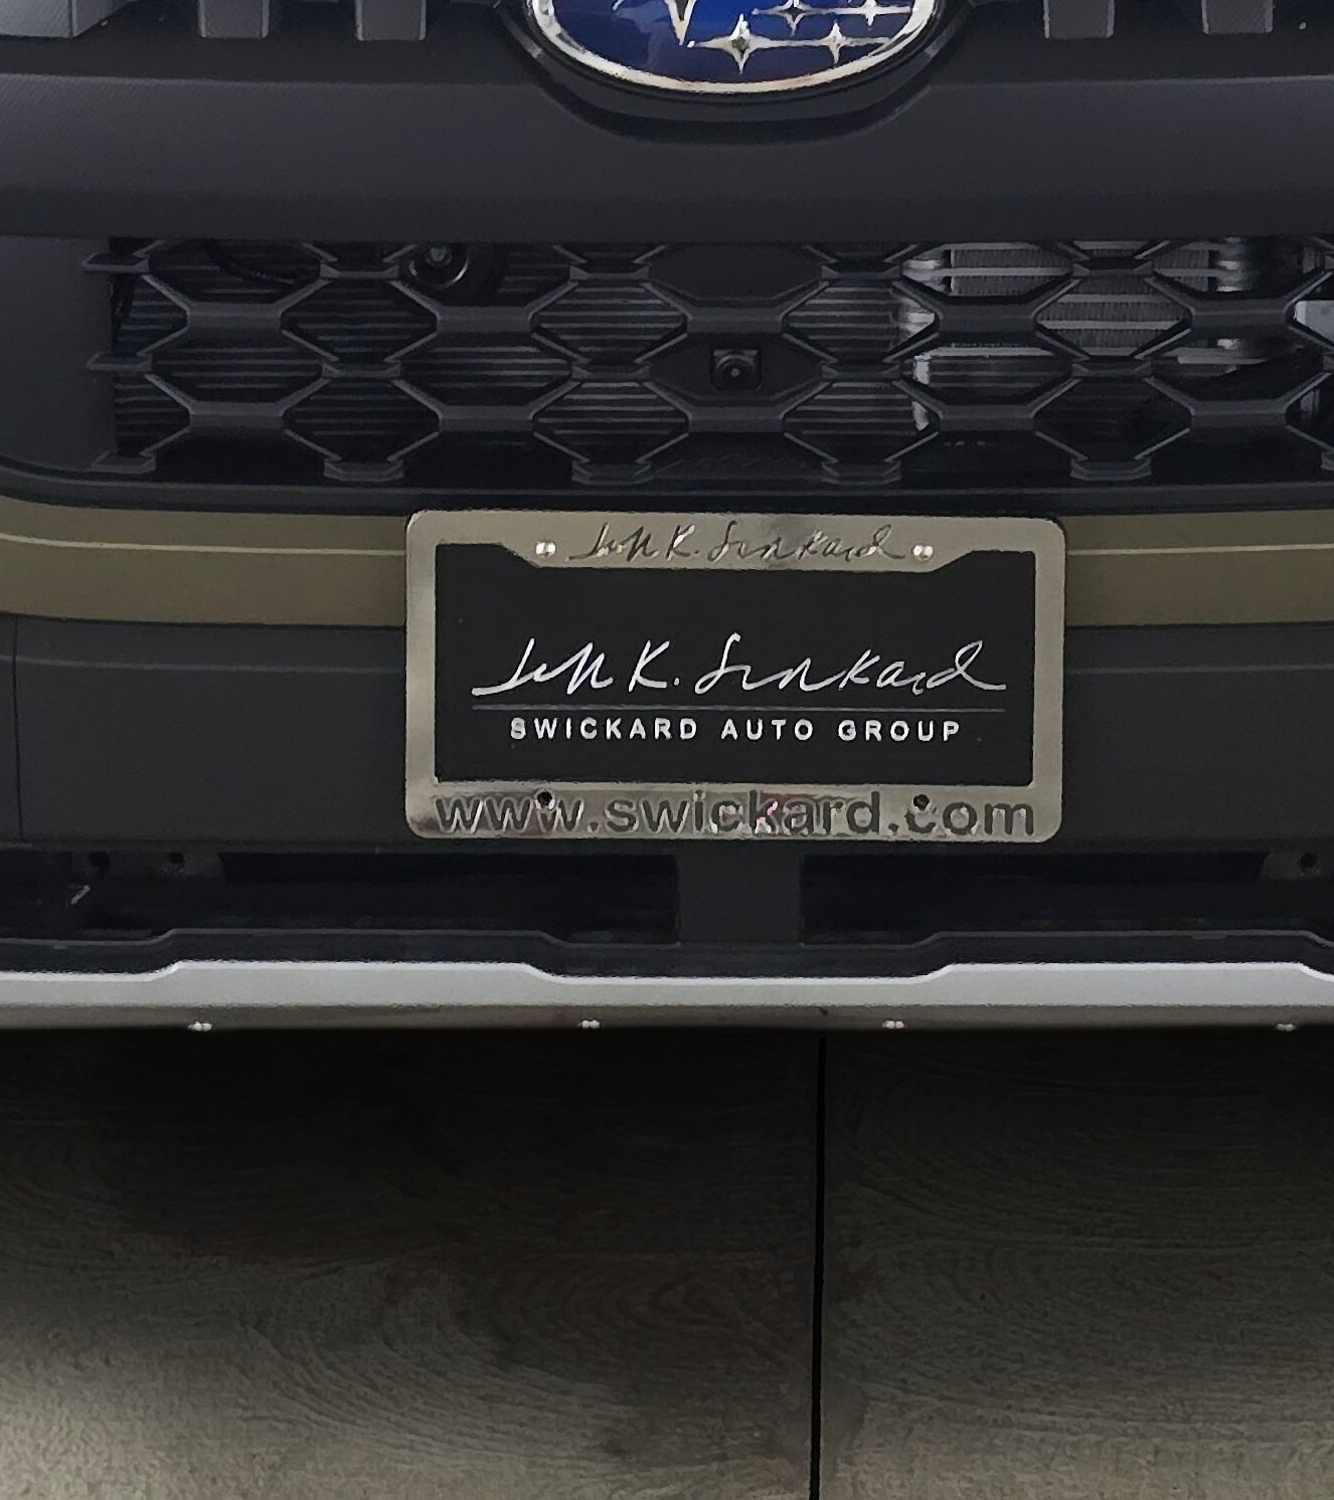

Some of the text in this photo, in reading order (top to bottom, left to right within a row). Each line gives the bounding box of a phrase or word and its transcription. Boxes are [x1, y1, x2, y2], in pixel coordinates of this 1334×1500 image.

[509, 717, 961, 742] SWICKARD AUTO GROUP
[434, 790, 1036, 837] www.swickard.com
